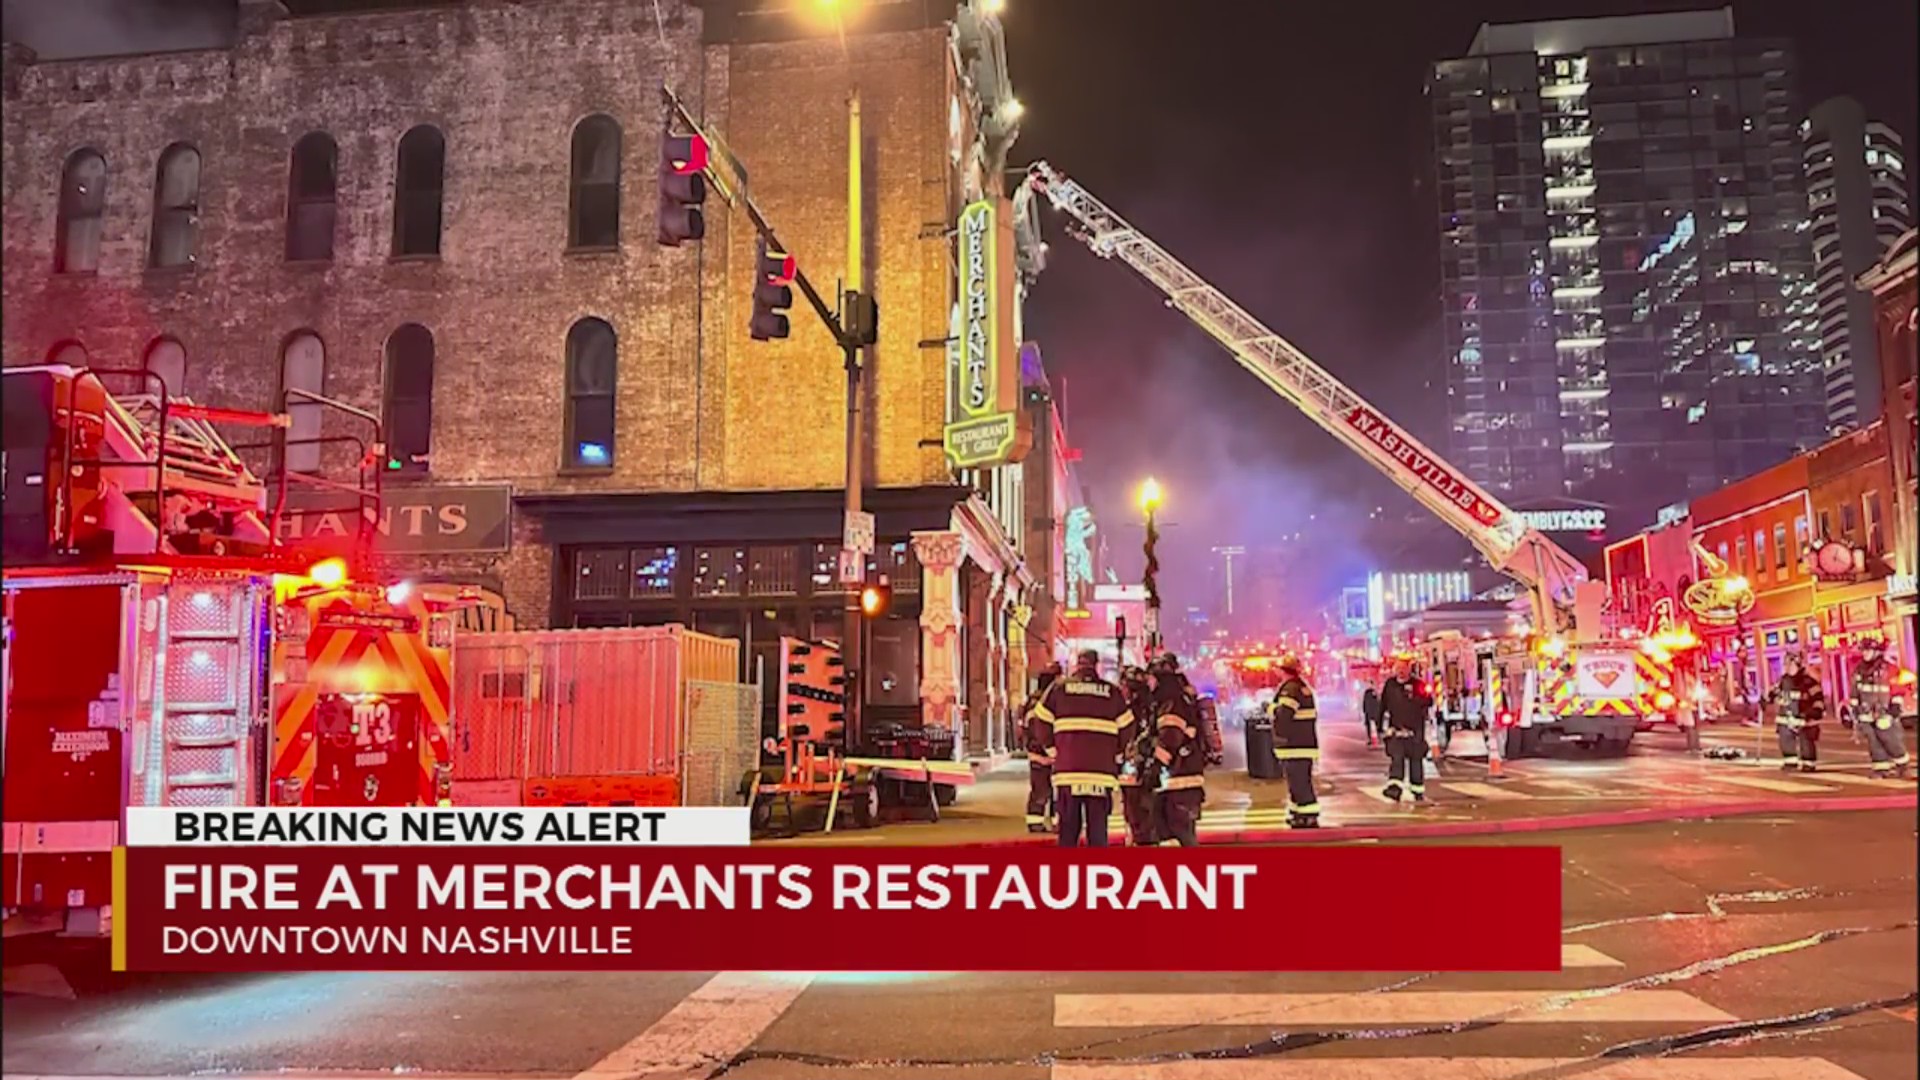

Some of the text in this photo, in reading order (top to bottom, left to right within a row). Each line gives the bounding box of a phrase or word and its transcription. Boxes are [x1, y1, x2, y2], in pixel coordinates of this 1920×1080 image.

[965, 207, 986, 406] MERCHANTS
[1355, 412, 1476, 509] NASHVILLE
[352, 702, 391, 746] T3
[1065, 682, 1111, 698] NASHVILLE
